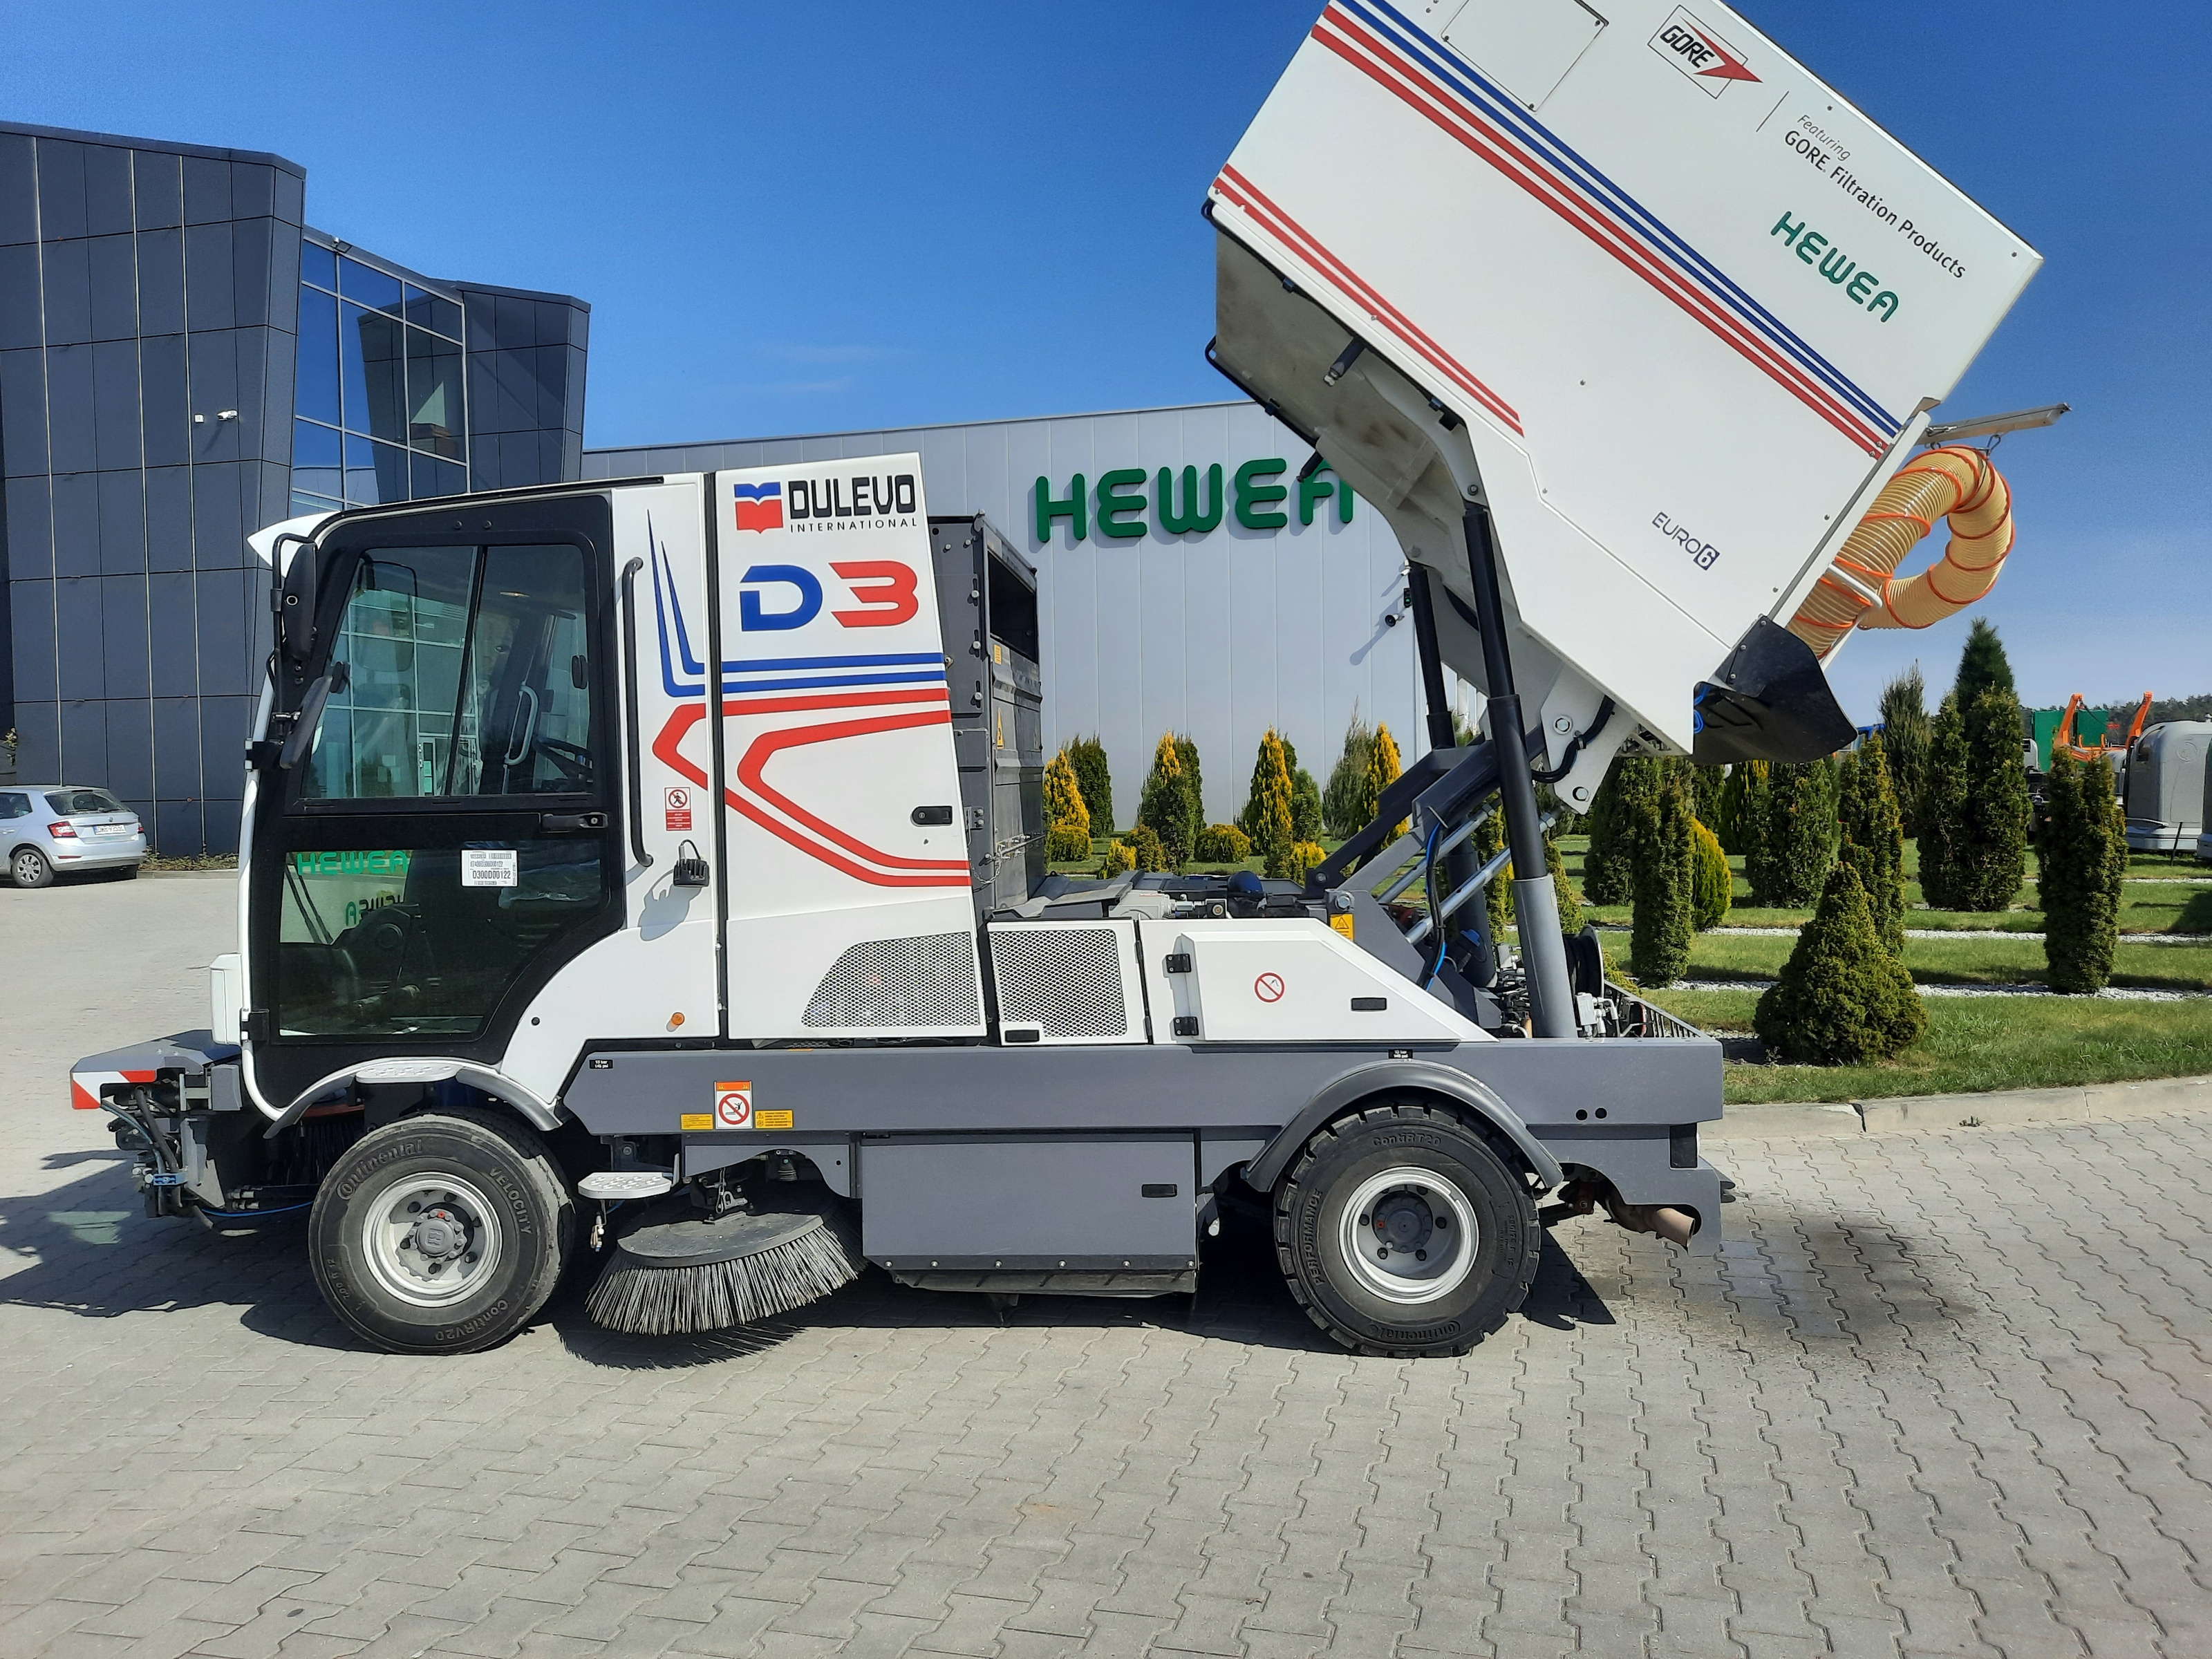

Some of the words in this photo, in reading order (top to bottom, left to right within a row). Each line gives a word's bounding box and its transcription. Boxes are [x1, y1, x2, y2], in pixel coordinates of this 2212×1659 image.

[1660, 25, 1715, 68] GORE
[1797, 114, 1850, 161] Featuring
[1830, 166, 1897, 225] Filtration
[1897, 219, 1966, 278] Products
[1770, 211, 1899, 322] HEWEA
[788, 474, 916, 519] DULEVO
[790, 517, 917, 533] INTERNATIONAL
[1036, 458, 1354, 543] HEWEA
[740, 560, 919, 632] D3
[297, 850, 408, 875] HEWEA
[337, 1138, 422, 1200] Continental
[490, 1166, 532, 1235] VELOCITY
[1303, 1188, 1325, 1286] PERFORMANCE
[434, 1300, 509, 1341] ContiRV20
